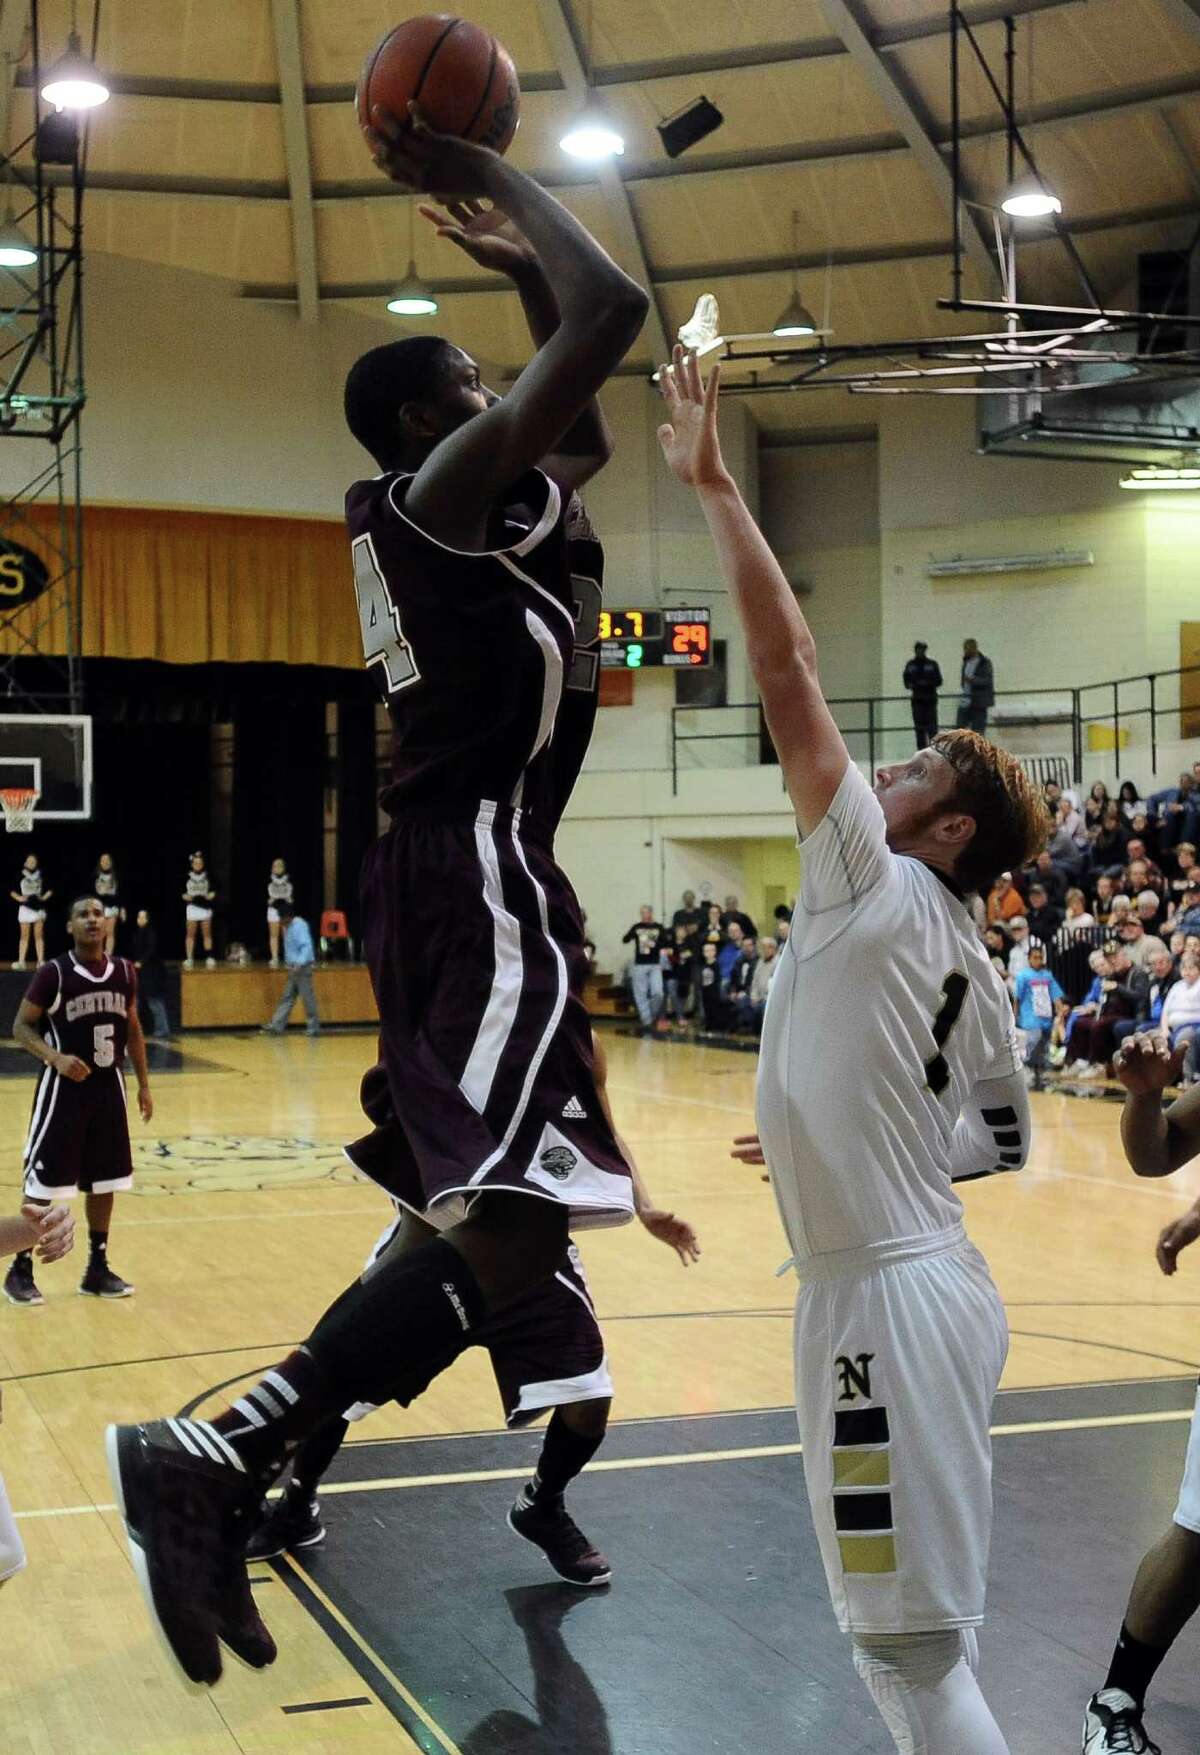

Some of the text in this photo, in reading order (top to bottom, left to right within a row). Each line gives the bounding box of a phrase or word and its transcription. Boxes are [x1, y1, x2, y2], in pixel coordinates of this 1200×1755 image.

[0, 553, 24, 596] S
[352, 532, 421, 693] 4
[627, 644, 642, 667] 2
[673, 625, 707, 652] 29
[94, 1023, 114, 1067] 5
[562, 1110, 587, 1118] adidas
[835, 1353, 875, 1401] N
